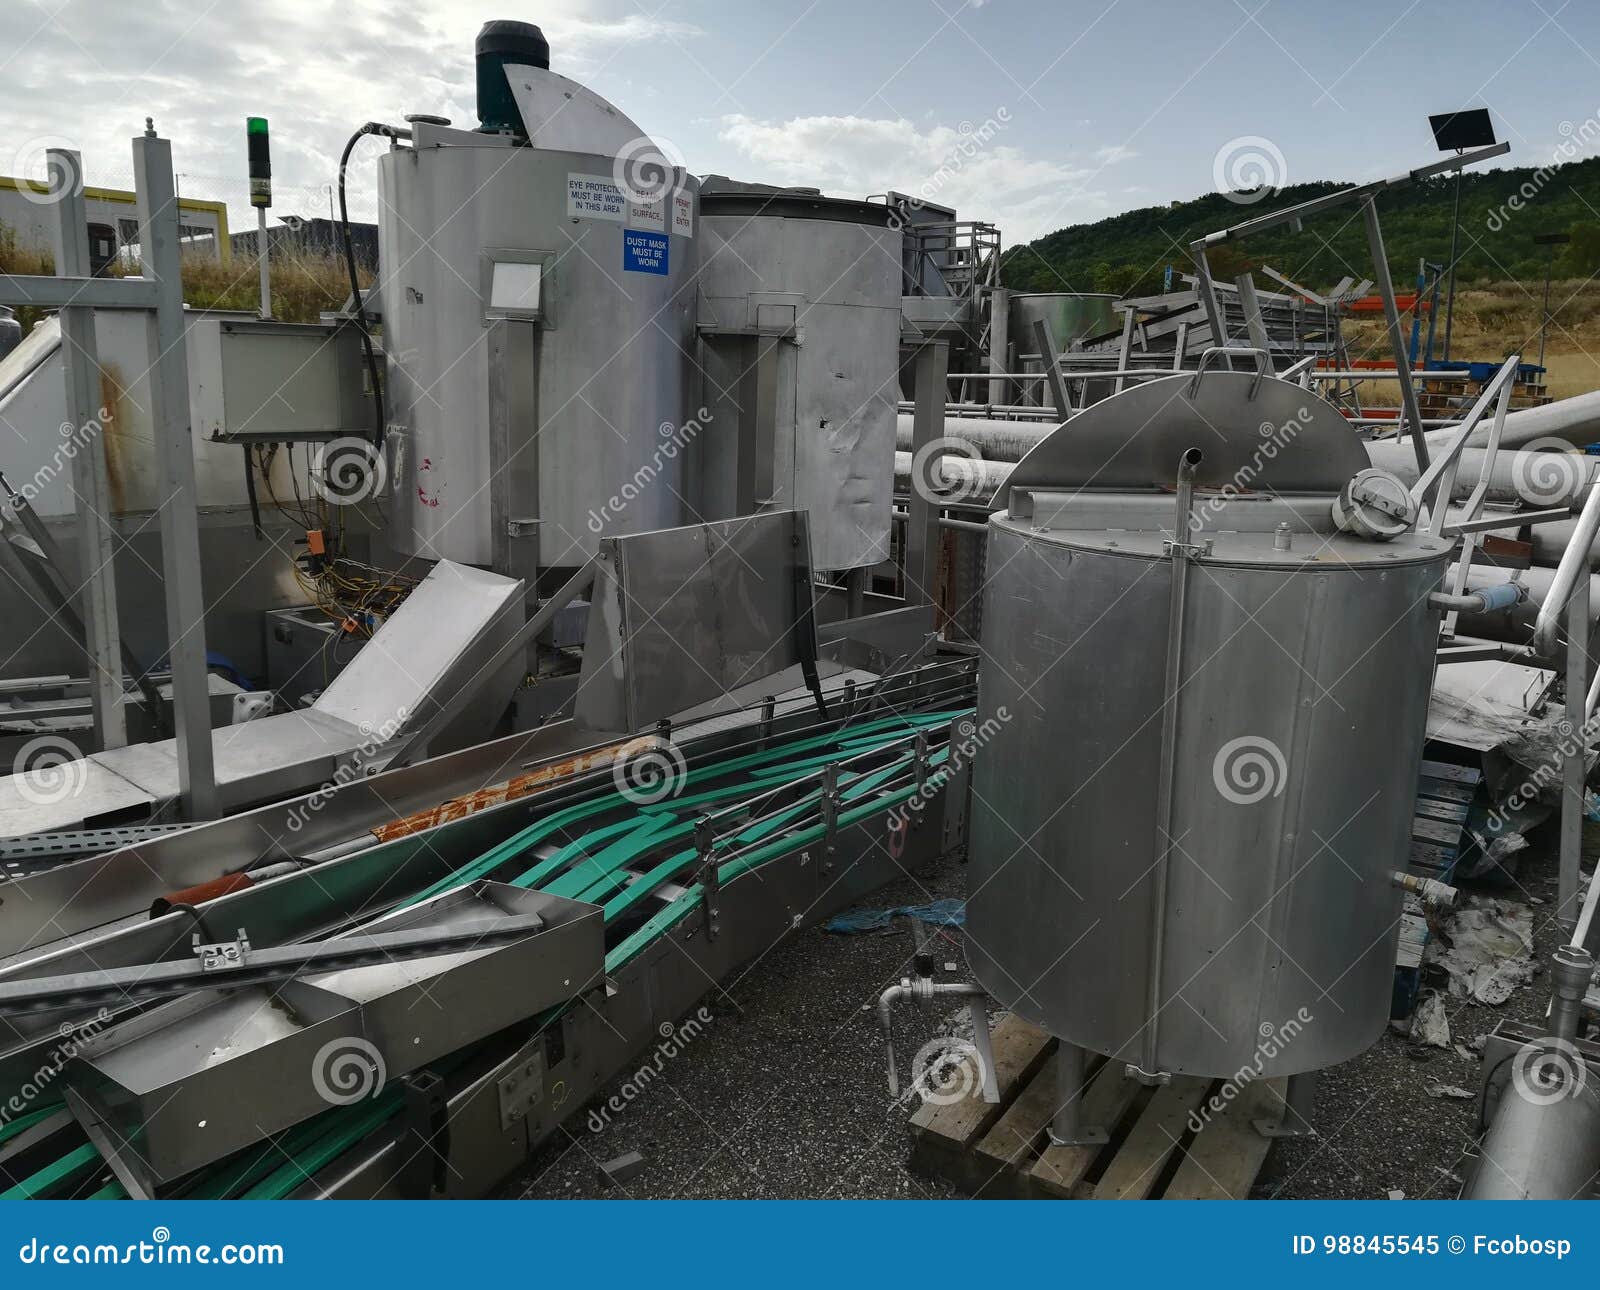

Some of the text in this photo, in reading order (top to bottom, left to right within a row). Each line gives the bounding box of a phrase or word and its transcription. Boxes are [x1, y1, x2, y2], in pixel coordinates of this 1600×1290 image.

[569, 180, 583, 190] EYE
[571, 191, 625, 205] MUST BE WORN
[585, 203, 601, 212] THIS
[603, 205, 620, 213] AREA
[626, 236, 667, 249] DUST MASK
[632, 247, 663, 258] MUST BE
[637, 257, 659, 267] WORN
